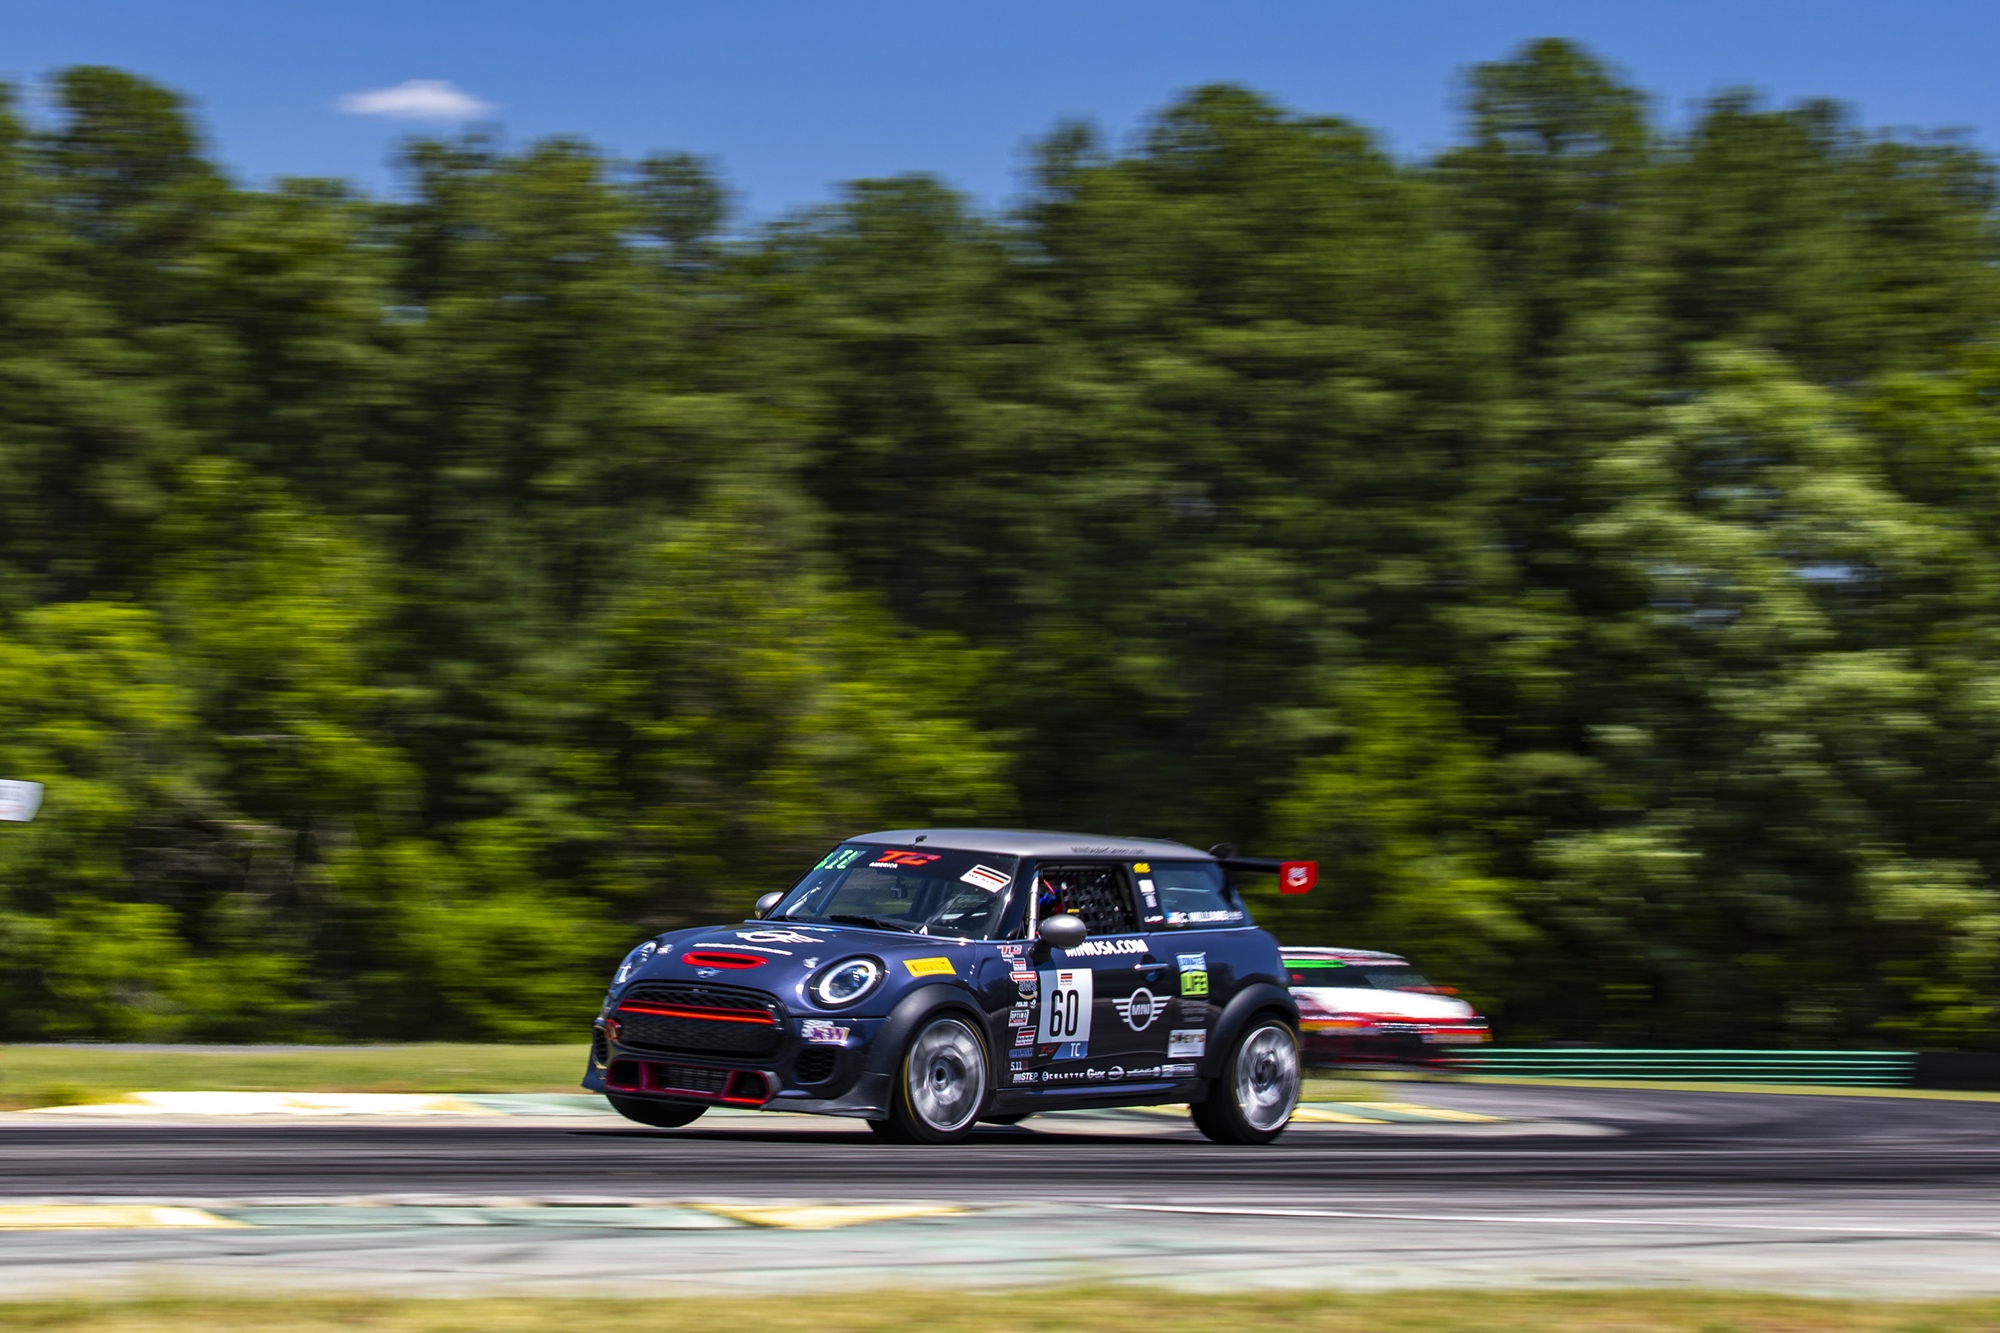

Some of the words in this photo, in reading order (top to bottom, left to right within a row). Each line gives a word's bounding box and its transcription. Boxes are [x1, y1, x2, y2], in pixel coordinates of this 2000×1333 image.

[1065, 939, 1148, 956] MINIUSA.COM
[1050, 990, 1078, 1036] 60
[1132, 1004, 1151, 1015] MINI
[1070, 1043, 1080, 1056] TC
[1010, 1061, 1022, 1071] 5.11
[1021, 1072, 1038, 1081] STEP
